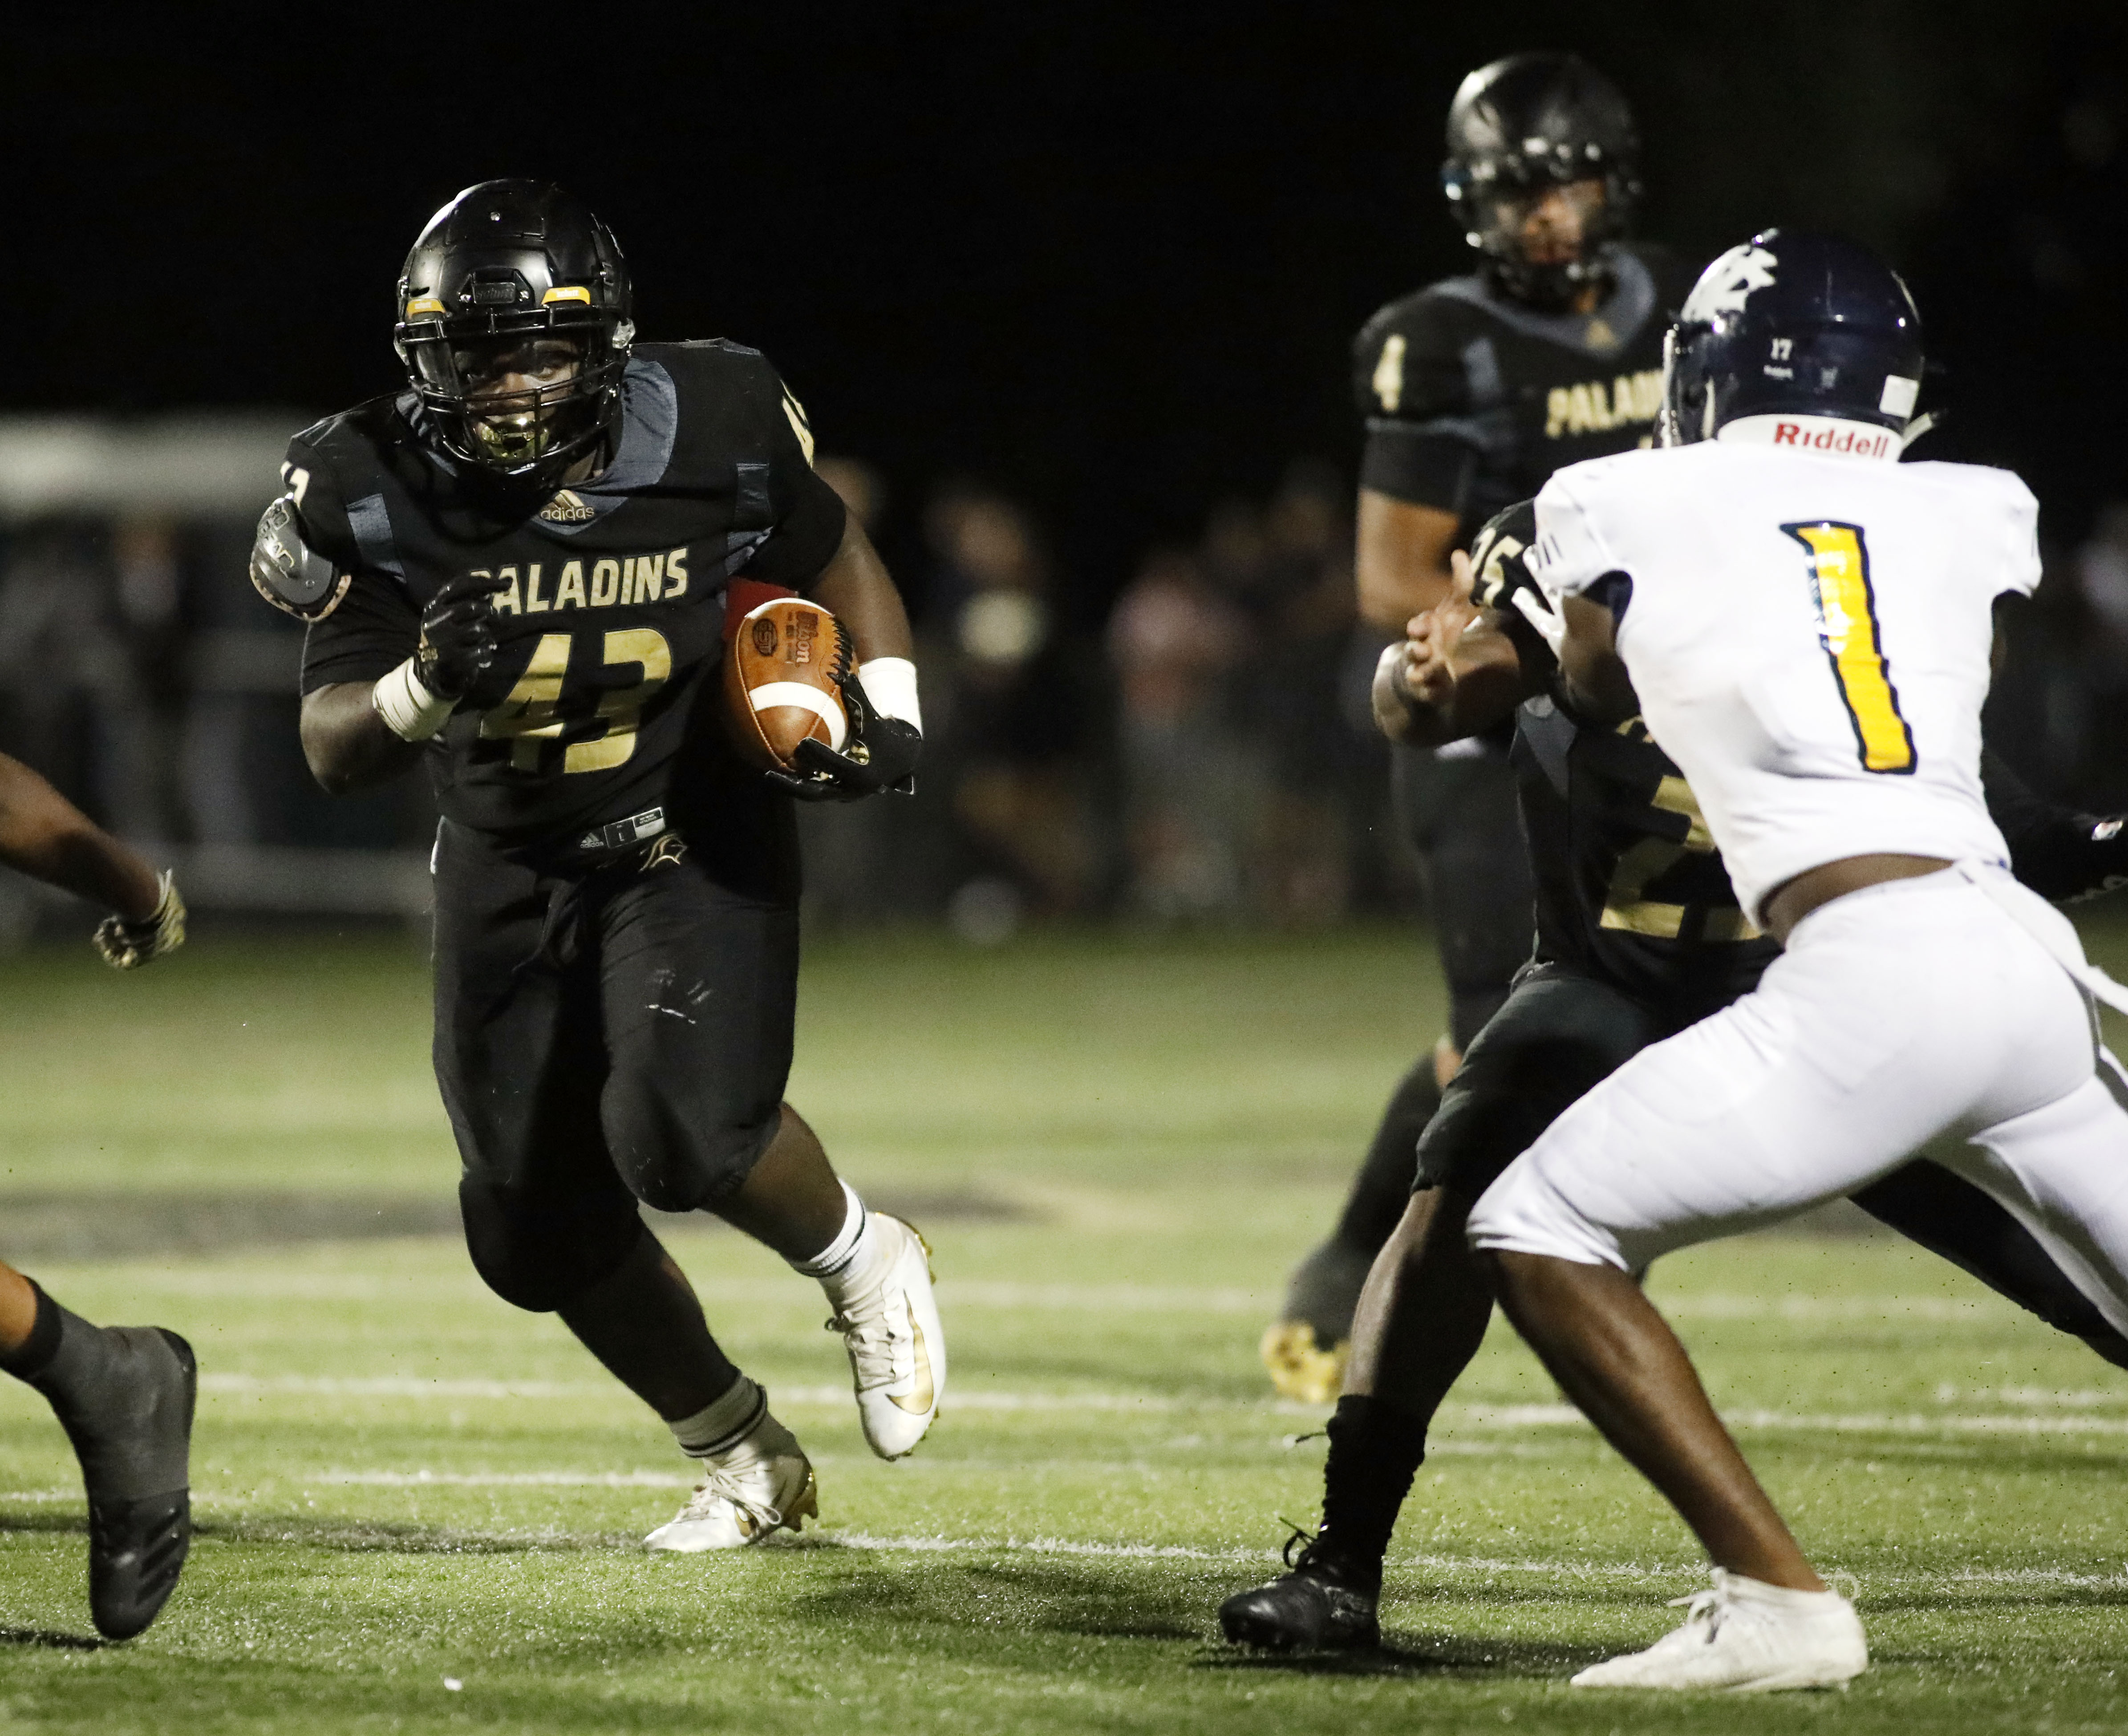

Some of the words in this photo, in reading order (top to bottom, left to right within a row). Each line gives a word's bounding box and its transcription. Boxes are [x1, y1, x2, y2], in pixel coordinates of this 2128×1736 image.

[556, 289, 579, 298] schutt
[1372, 335, 1406, 412] 4
[1774, 422, 1889, 458] Riddell
[541, 506, 594, 521] adidas
[470, 548, 688, 615] ALADINS
[1779, 521, 1917, 775] 1
[479, 628, 672, 773] 43
[618, 833, 624, 841] L
[1600, 775, 1761, 940] 2
